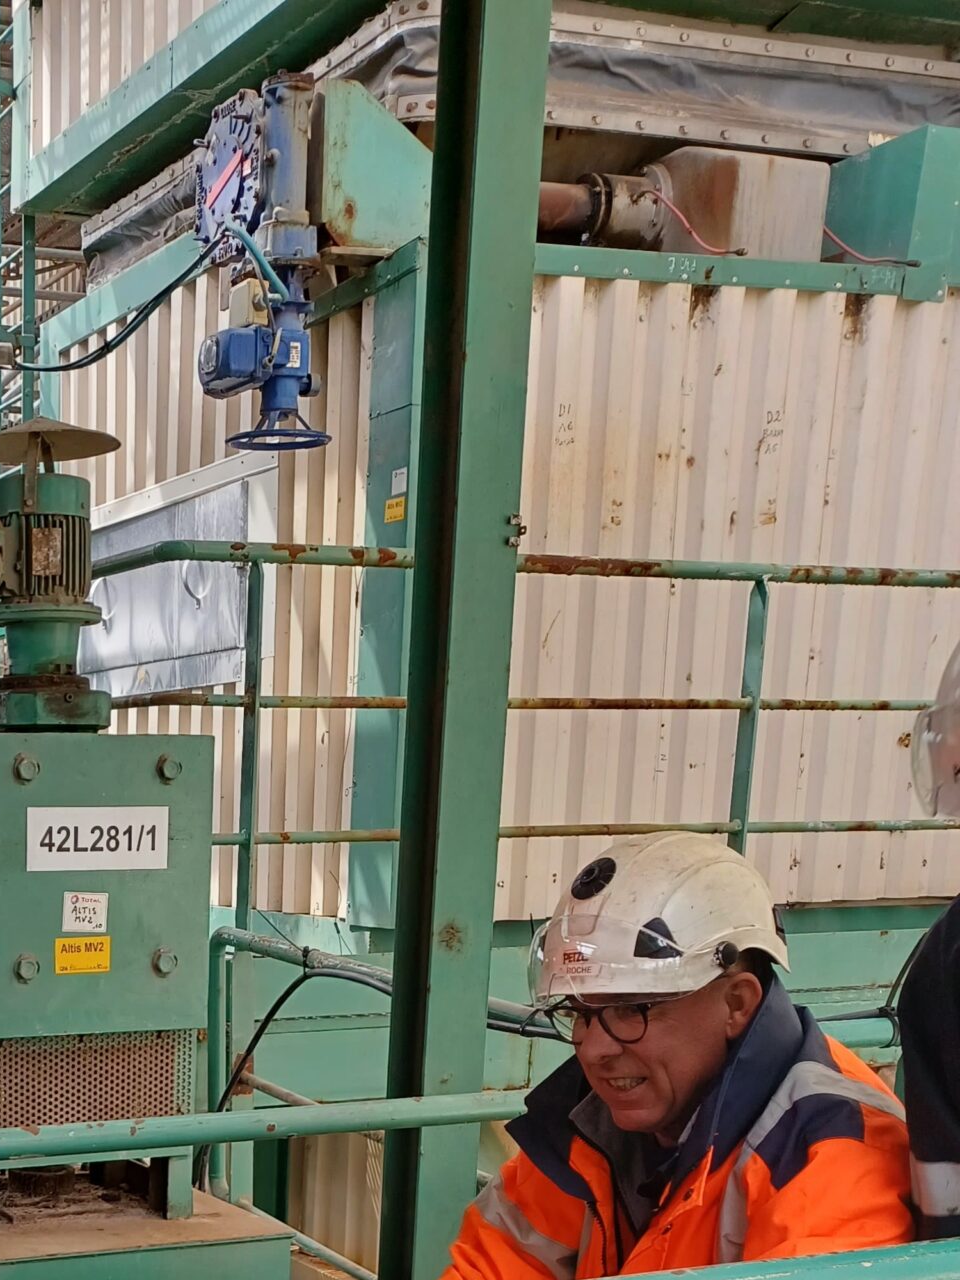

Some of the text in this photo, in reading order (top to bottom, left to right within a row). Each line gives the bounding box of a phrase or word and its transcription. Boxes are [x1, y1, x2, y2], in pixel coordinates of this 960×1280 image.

[40, 825, 156, 852] 42L281/1
[71, 905, 97, 915] ALTIS
[74, 916, 93, 924] MV2
[60, 941, 105, 953] Altis MV2
